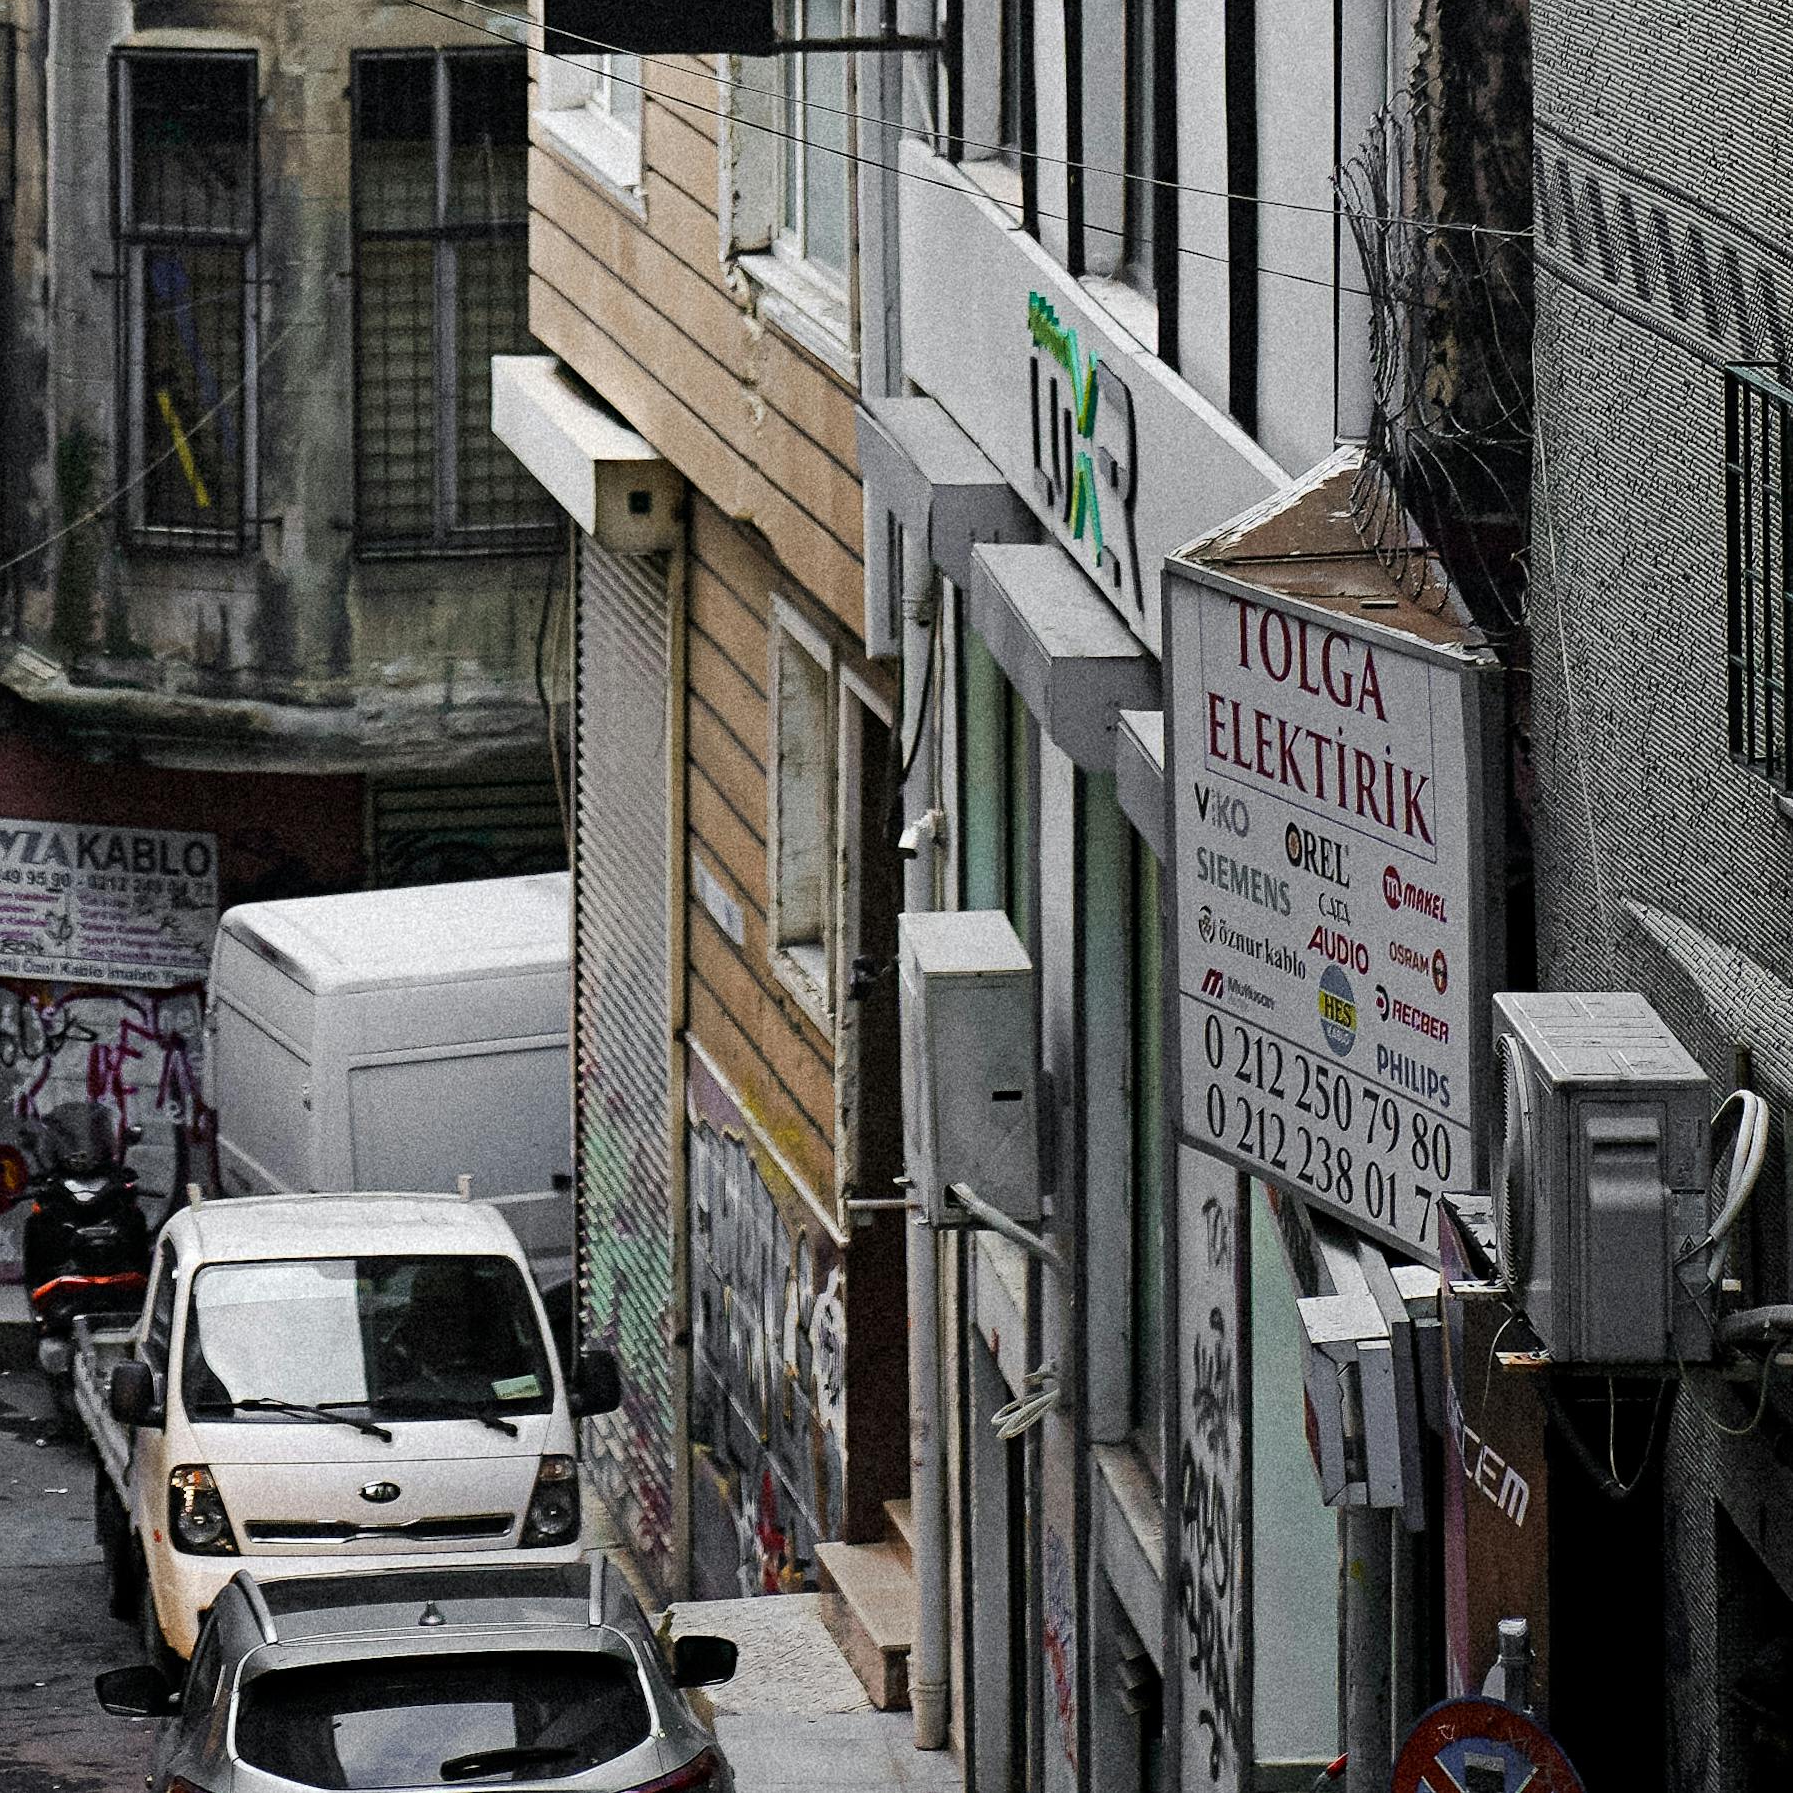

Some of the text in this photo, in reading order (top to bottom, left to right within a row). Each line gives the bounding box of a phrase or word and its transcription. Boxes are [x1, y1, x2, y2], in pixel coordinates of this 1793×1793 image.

[1229, 595, 1389, 723] TOLGA
[1207, 691, 1436, 846] ELEKTİRİK
[76, 832, 212, 877] KABLO
[1196, 846, 1291, 916] SIEMENS
[1285, 822, 1350, 889] OREL
[1402, 884, 1448, 923] MAKEL
[1218, 918, 1307, 981] öznur kablo
[1307, 925, 1369, 975] AUDIO
[1389, 941, 1429, 976] OSRAM
[1324, 992, 1352, 1028] HES
[1205, 1014, 1451, 1181] 0 212 250 79 80
[1377, 1043, 1450, 1108] PHILIPS
[1206, 1083, 1441, 1248] 0 212 238 01 7
